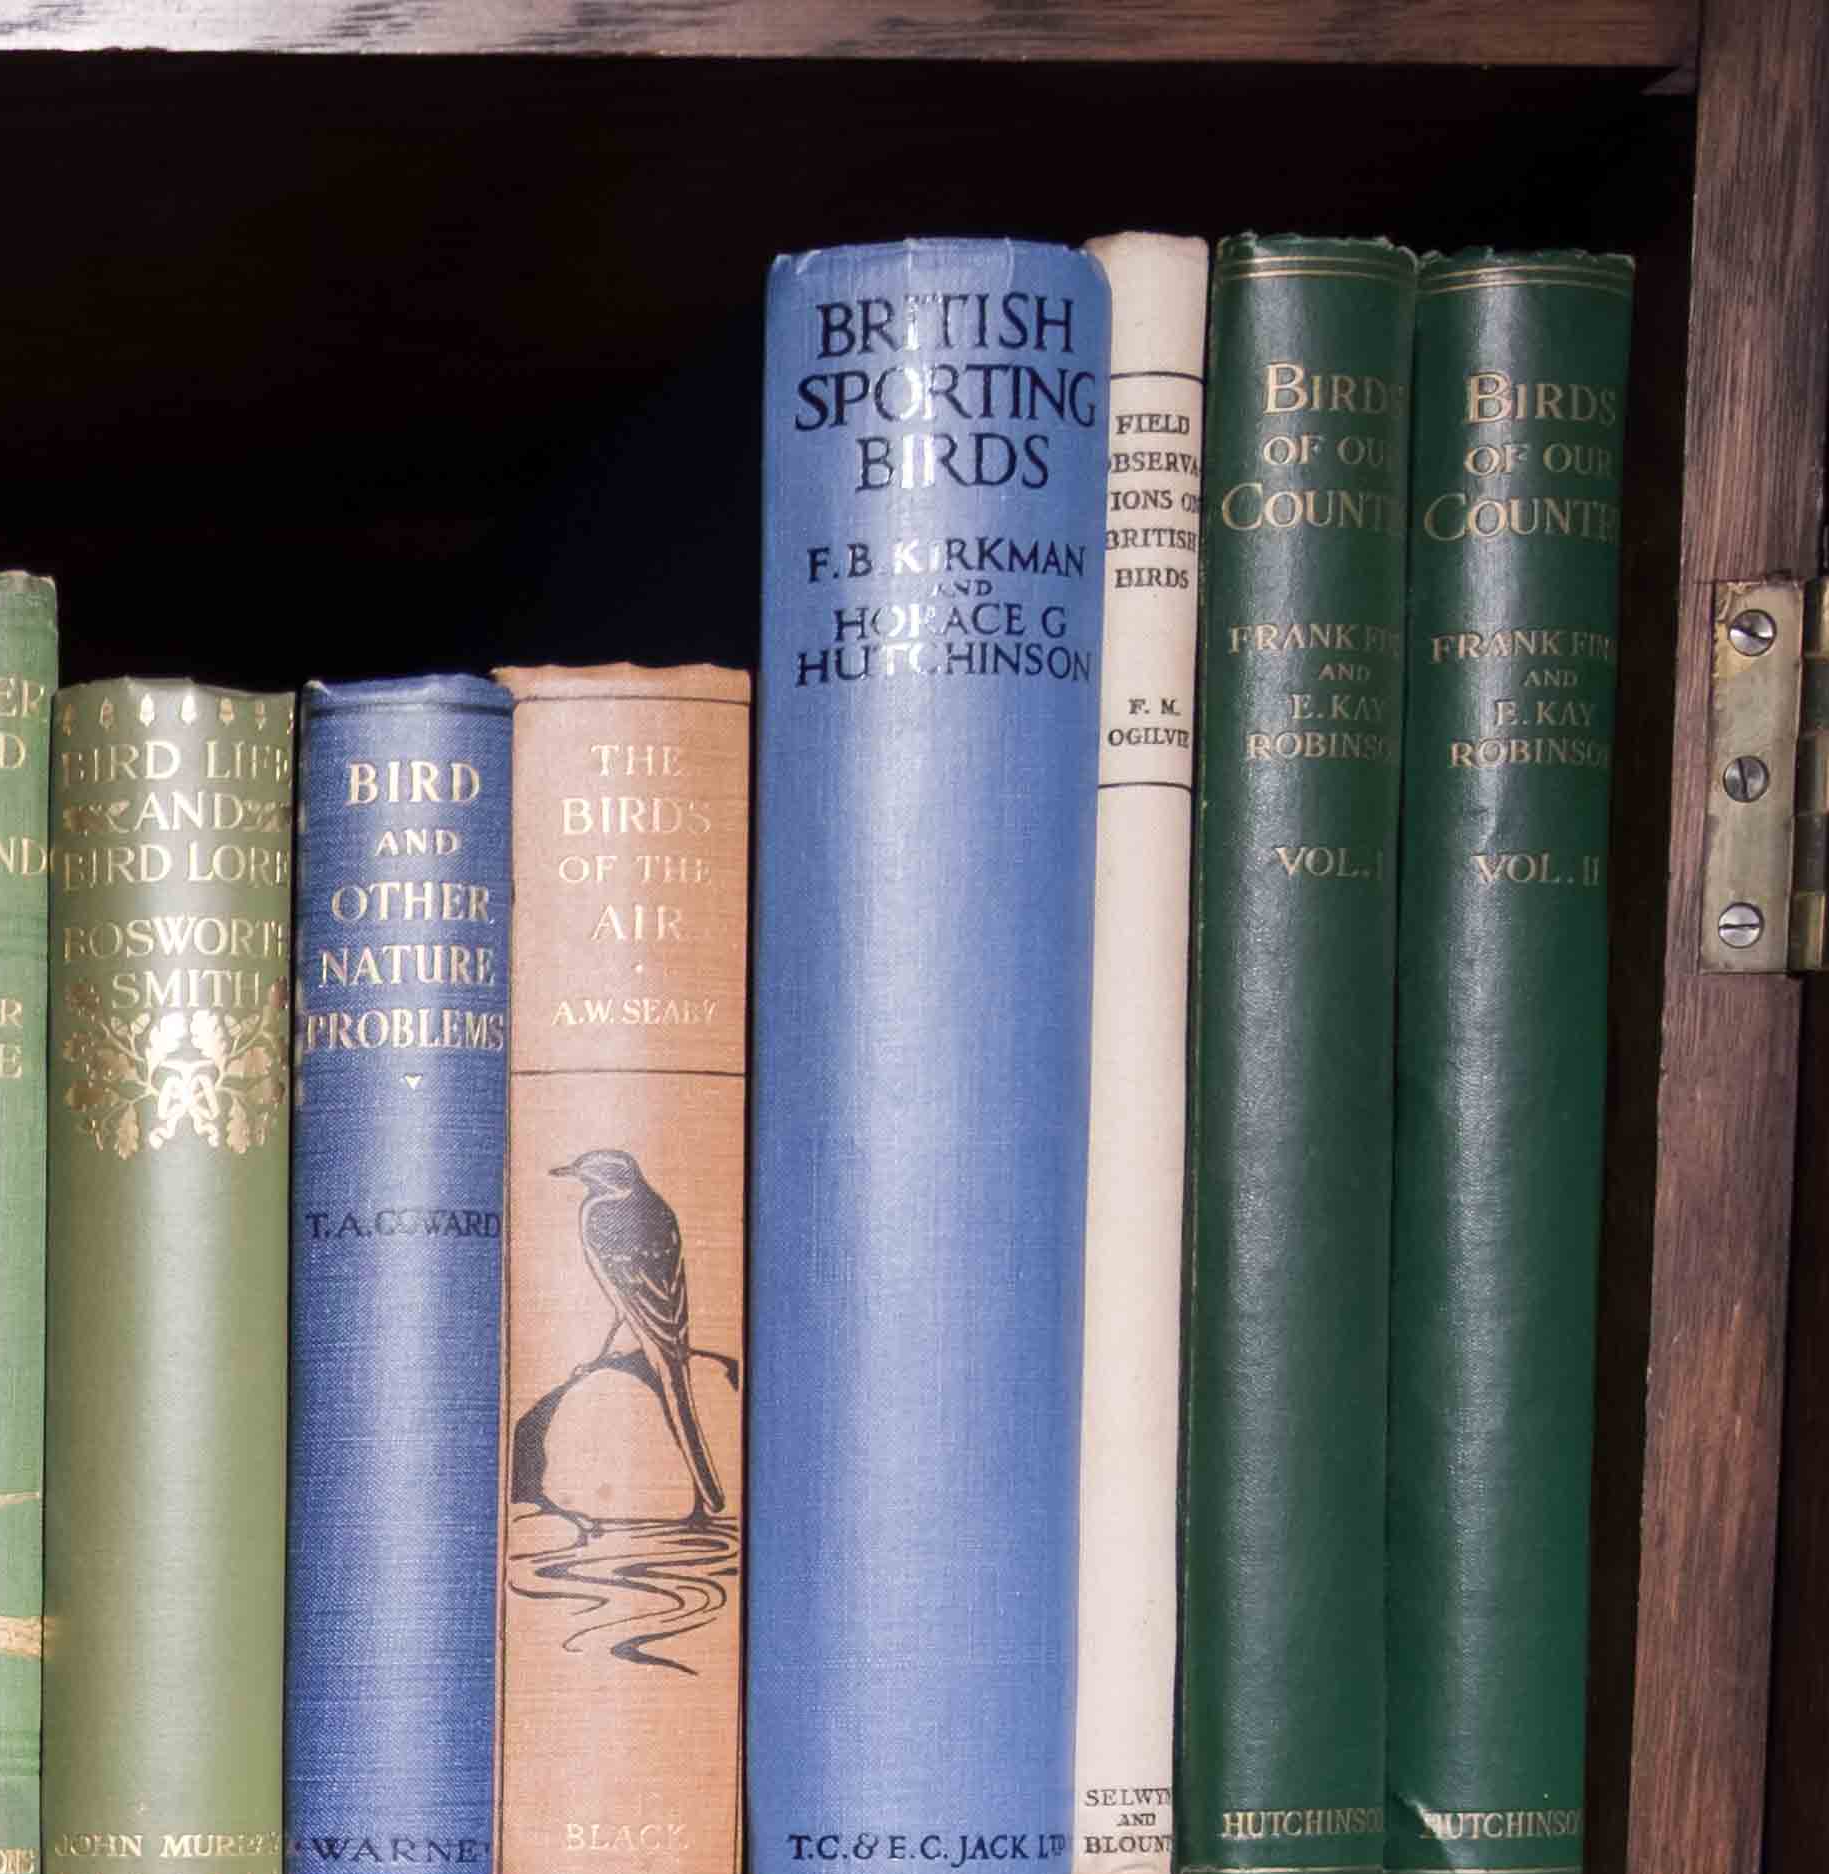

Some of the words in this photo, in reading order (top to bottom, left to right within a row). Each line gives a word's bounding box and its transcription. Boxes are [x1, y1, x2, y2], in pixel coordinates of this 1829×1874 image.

[795, 363, 1096, 432] SPORTING
[1467, 372, 1616, 424] BIRDS
[1115, 415, 1190, 437] FIELD
[856, 432, 1051, 493] BIRDS
[1114, 568, 1189, 589] BIRDS
[1431, 631, 1560, 665] FRANK
[591, 743, 682, 778] THE
[347, 760, 481, 804] BIRD
[135, 791, 242, 832] AND
[562, 798, 711, 835] BIRDS
[374, 829, 461, 857] AND
[559, 855, 617, 885] OF
[591, 905, 682, 943] AIR
[319, 944, 495, 988] NATURE
[112, 969, 260, 1010] SMITH
[565, 1823, 685, 1852] BLACK
